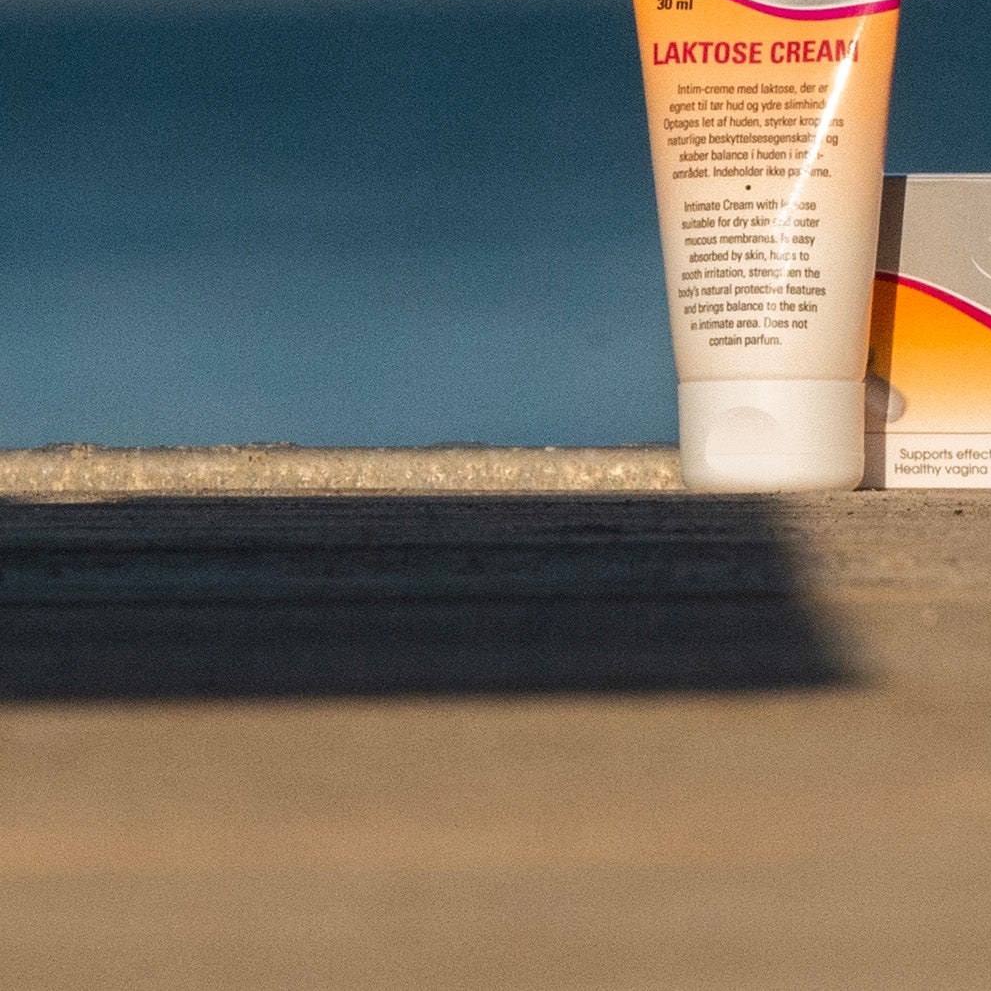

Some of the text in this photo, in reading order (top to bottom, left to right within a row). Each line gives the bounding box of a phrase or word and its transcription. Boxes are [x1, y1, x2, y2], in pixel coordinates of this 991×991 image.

[653, 39, 859, 65] LAKTOSE CREAM
[677, 82, 829, 95] Intim-creme med laktose, der er
[669, 99, 826, 114] egnet til tør hud og ydre slimhind
[664, 116, 844, 130] Optages let af huden, styrker kropns
[667, 134, 706, 147] naturlige
[826, 135, 839, 146] og
[679, 151, 709, 162] skaber
[711, 150, 749, 161] balance
[757, 149, 787, 160] huden
[795, 150, 824, 160] int-
[713, 166, 764, 177] Indeholder
[766, 166, 785, 176] ikke
[788, 168, 832, 179] pame.
[684, 199, 816, 211] Intimate Cream with lose
[681, 218, 715, 230] suitable
[718, 217, 730, 227] for
[733, 217, 748, 229] dry
[751, 216, 770, 226] skin
[793, 217, 820, 227] outer
[684, 235, 717, 246] mucous
[719, 233, 777, 245] membranes.
[792, 235, 815, 247] easy
[689, 251, 729, 262] absorbed
[731, 251, 742, 263] by
[744, 250, 767, 262] skin,
[799, 252, 810, 261] to
[681, 267, 820, 280] sooth irritation, strengen the
[678, 284, 826, 298] body's natural protective features
[684, 301, 818, 315] and brings balance to the skin
[690, 318, 808, 330] in intimate area. Does not
[709, 335, 782, 347] contain parfum.
[900, 448, 953, 461] Supports
[894, 463, 941, 476] Healthy
[944, 464, 988, 477] vagina
